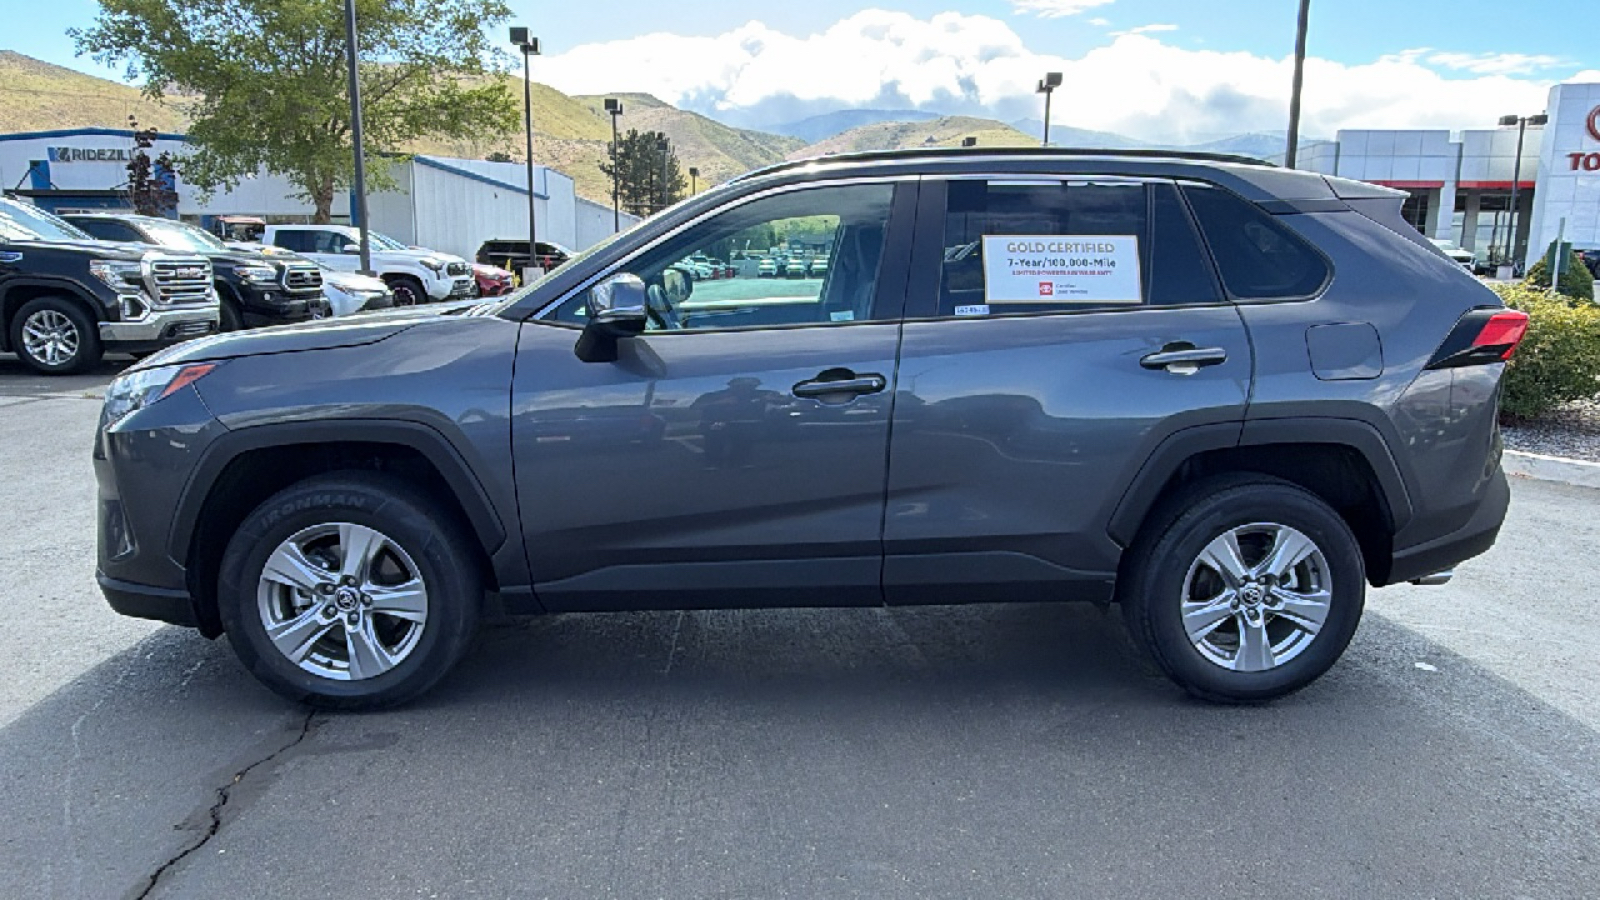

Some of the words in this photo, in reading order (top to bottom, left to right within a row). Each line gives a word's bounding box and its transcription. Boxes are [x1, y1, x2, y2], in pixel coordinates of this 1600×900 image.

[72, 149, 140, 161] RIDEZILL
[1007, 242, 1045, 253] GOLD
[1047, 242, 1115, 253] CERTIFIED
[1007, 257, 1116, 268] 7-Year/100,000-Mile
